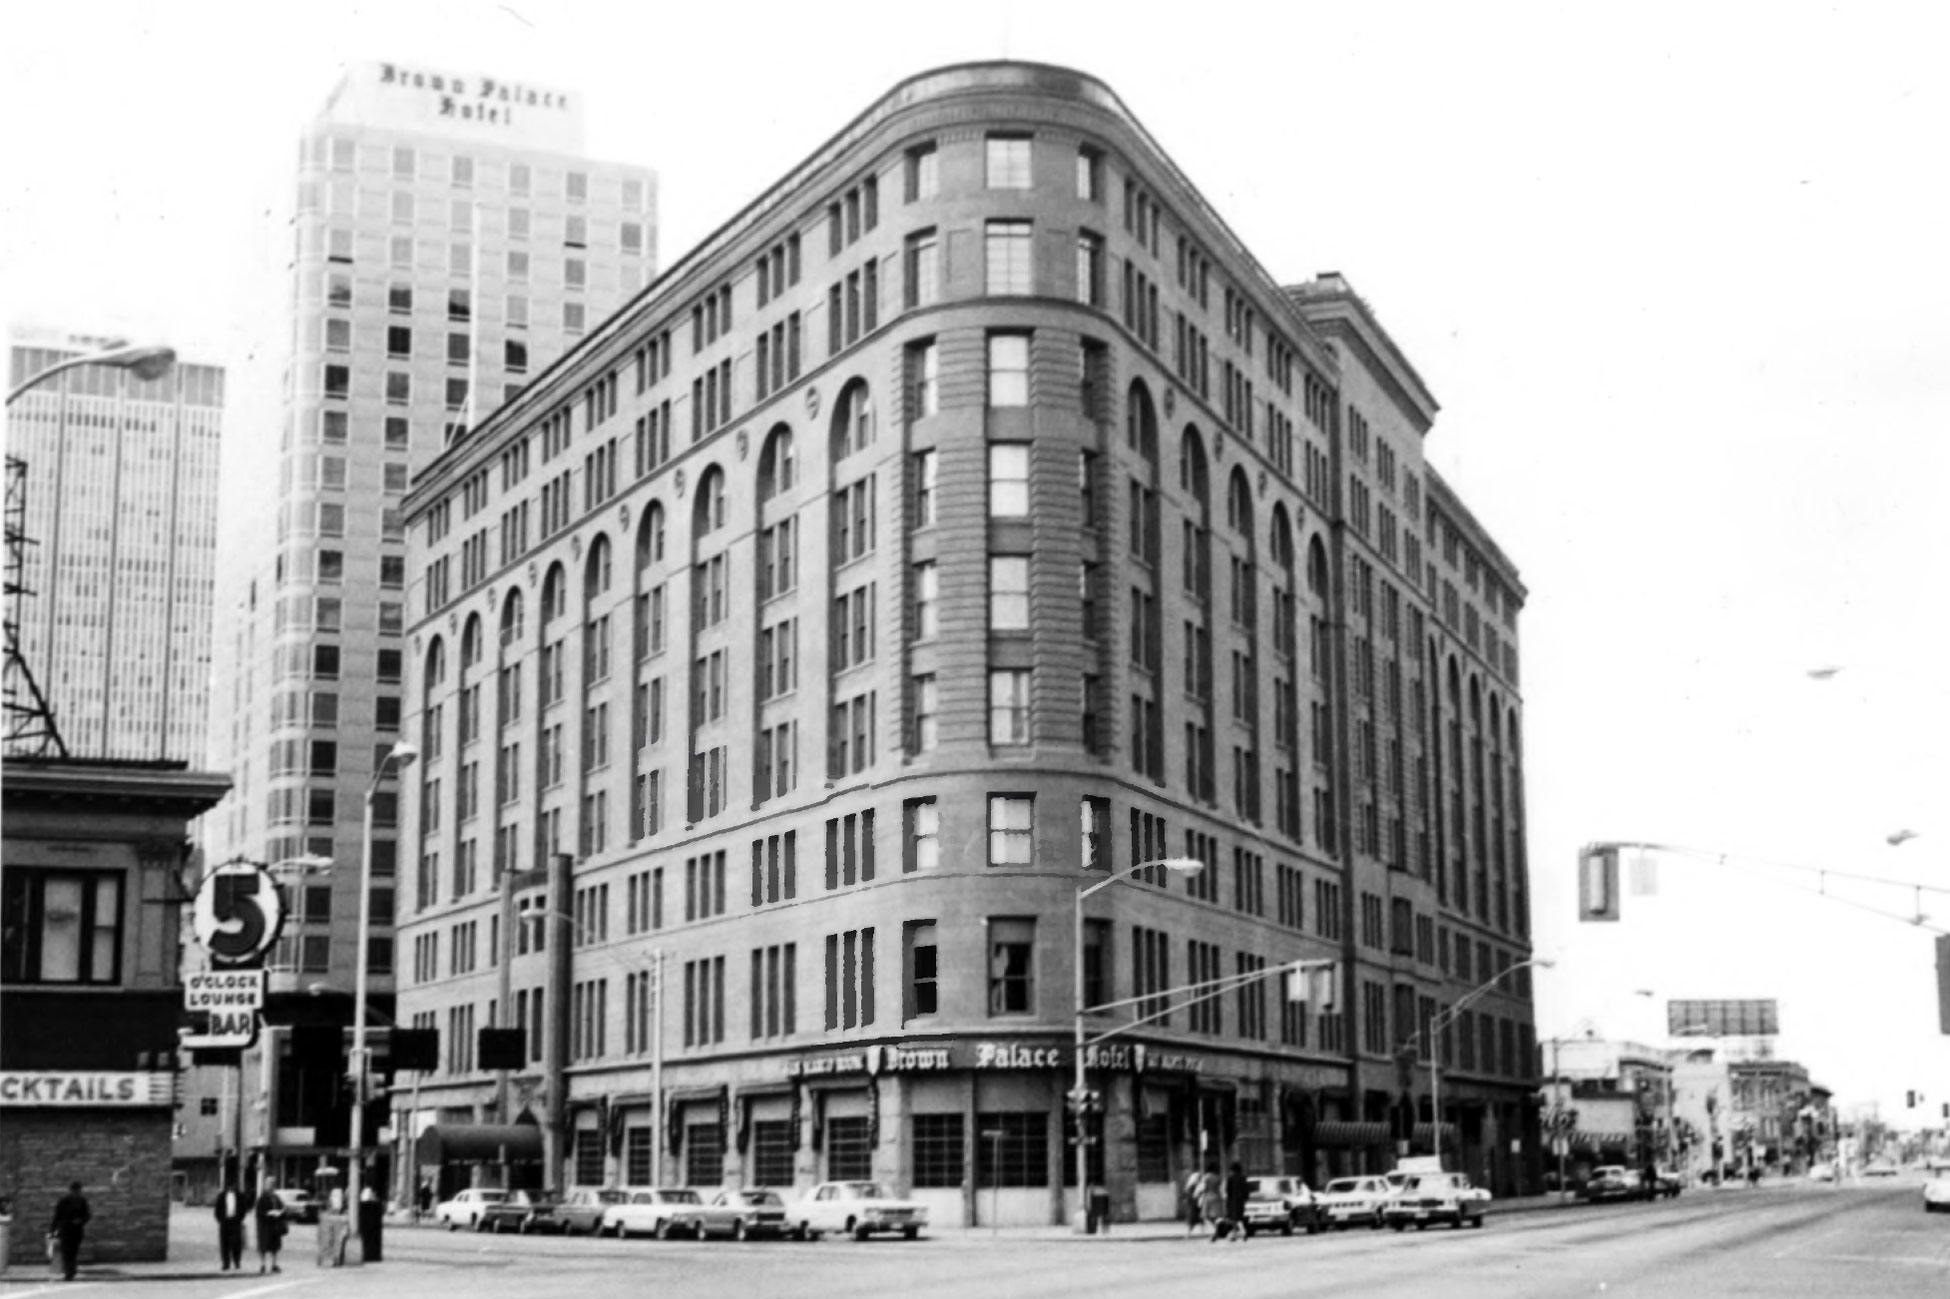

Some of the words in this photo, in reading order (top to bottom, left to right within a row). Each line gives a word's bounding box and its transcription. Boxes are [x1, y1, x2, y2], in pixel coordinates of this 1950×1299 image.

[380, 63, 465, 94] Brown
[481, 79, 567, 107] Palace
[439, 96, 511, 125] Hotel
[208, 874, 266, 957] 5
[190, 976, 257, 989] O'CLOCK
[190, 993, 256, 1006] LOUNGE
[211, 1013, 251, 1036] BAR
[885, 1045, 949, 1071] Brown
[975, 1042, 1060, 1068] Palace
[1082, 1044, 1131, 1069] Hotel
